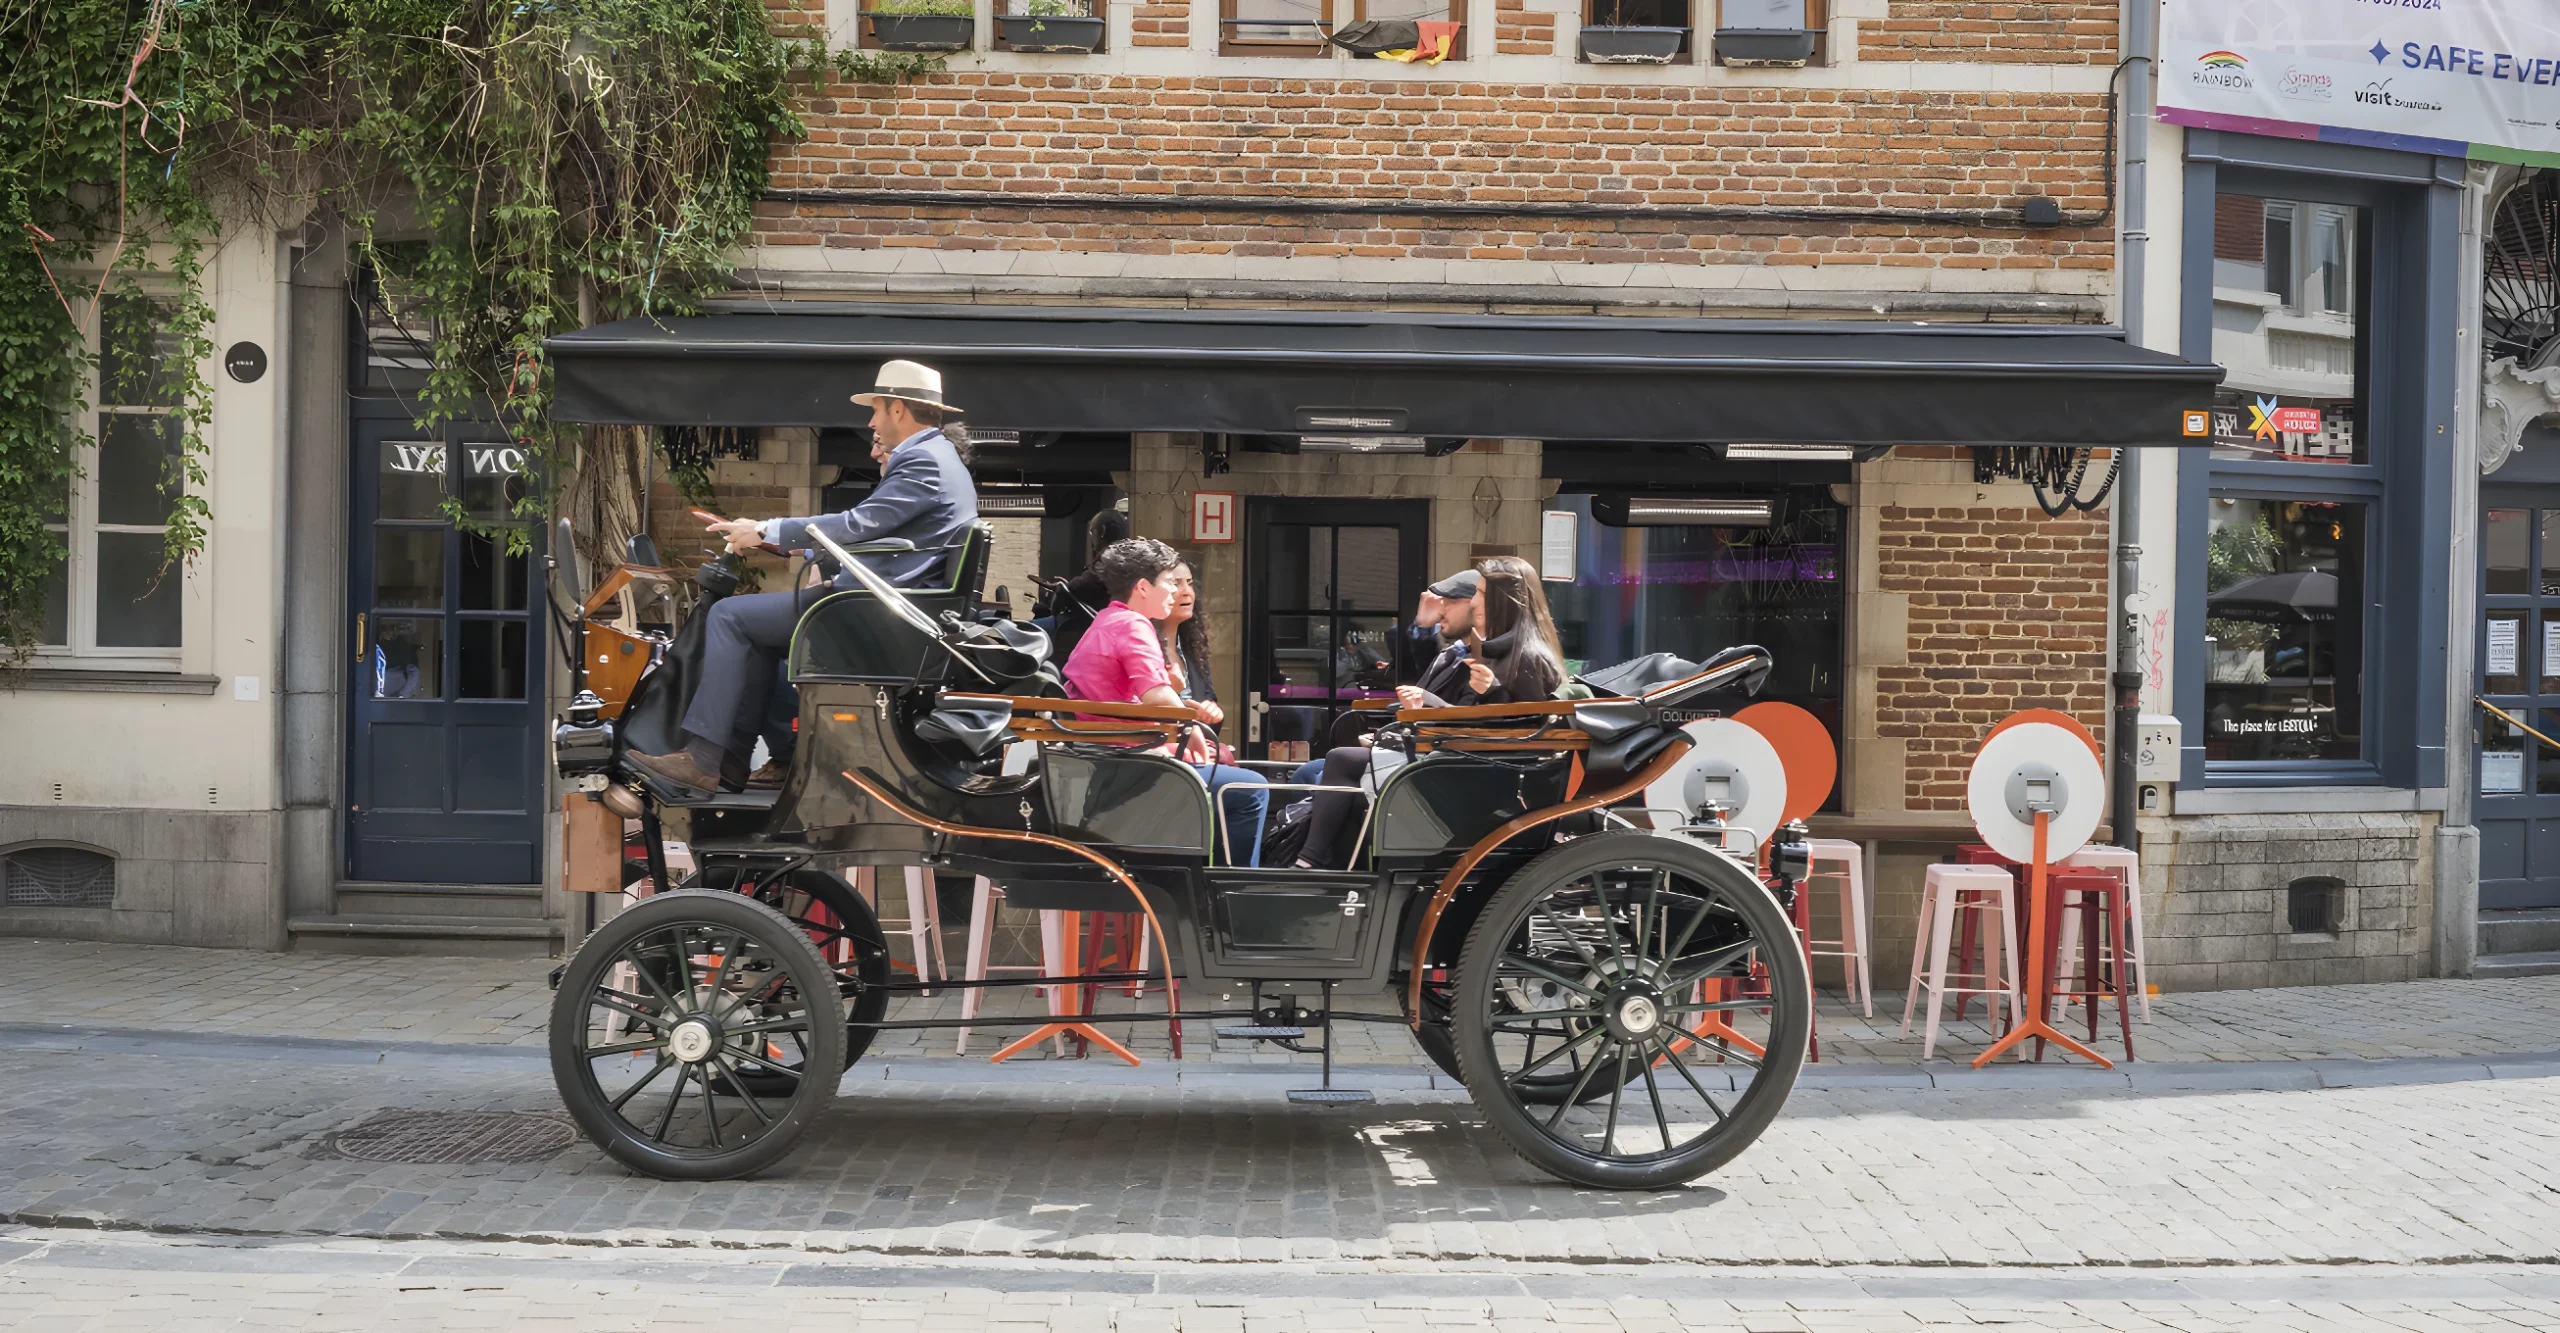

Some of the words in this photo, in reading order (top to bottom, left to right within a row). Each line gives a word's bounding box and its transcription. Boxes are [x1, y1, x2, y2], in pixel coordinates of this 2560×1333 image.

[2402, 42, 2484, 75] SAFE
[1202, 501, 1225, 534] H
[2223, 719, 2239, 732] The
[2240, 719, 2262, 735] place
[2265, 719, 2277, 732] for
